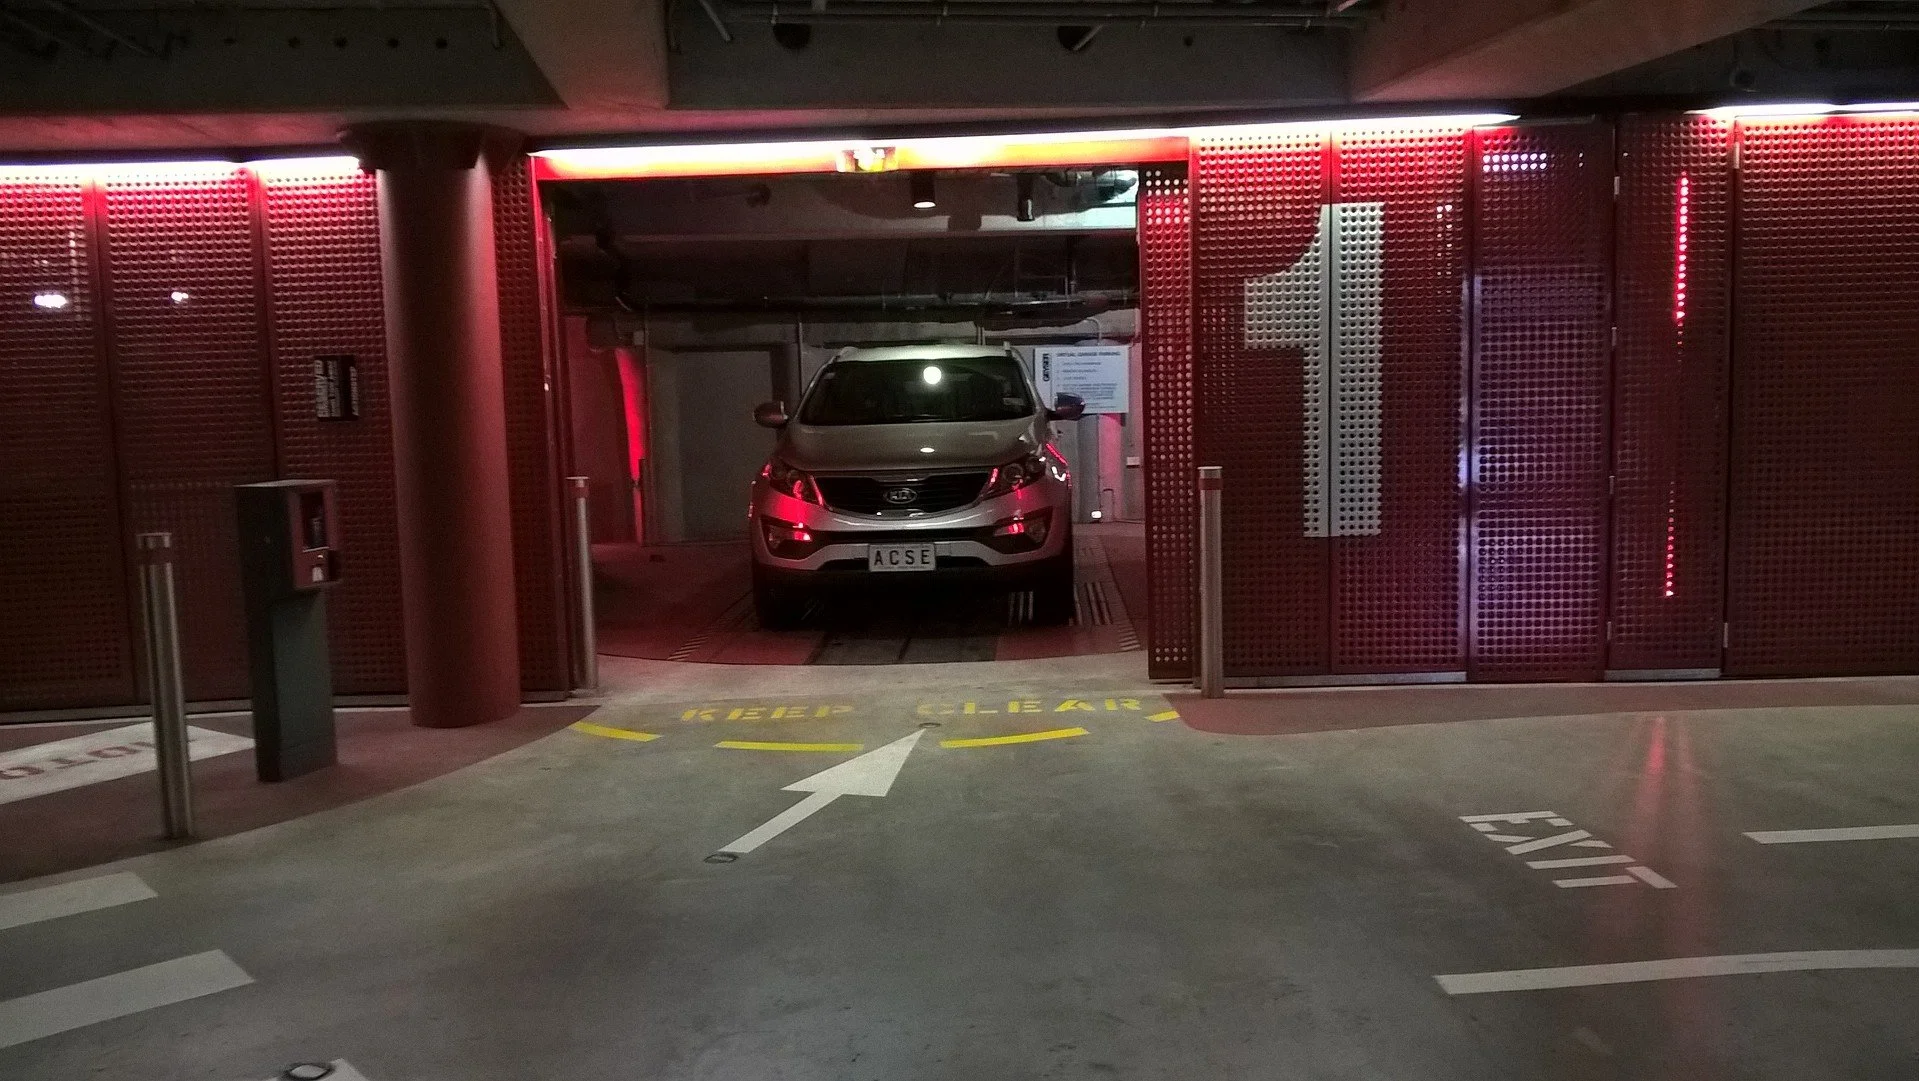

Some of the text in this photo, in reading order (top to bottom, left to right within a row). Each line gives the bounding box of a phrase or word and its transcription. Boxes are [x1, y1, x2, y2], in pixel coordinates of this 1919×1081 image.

[1244, 201, 1385, 537] 1
[873, 549, 931, 566] ACSE
[681, 697, 1143, 722] KEEP CLEAR
[1458, 810, 1678, 889] EXIT
